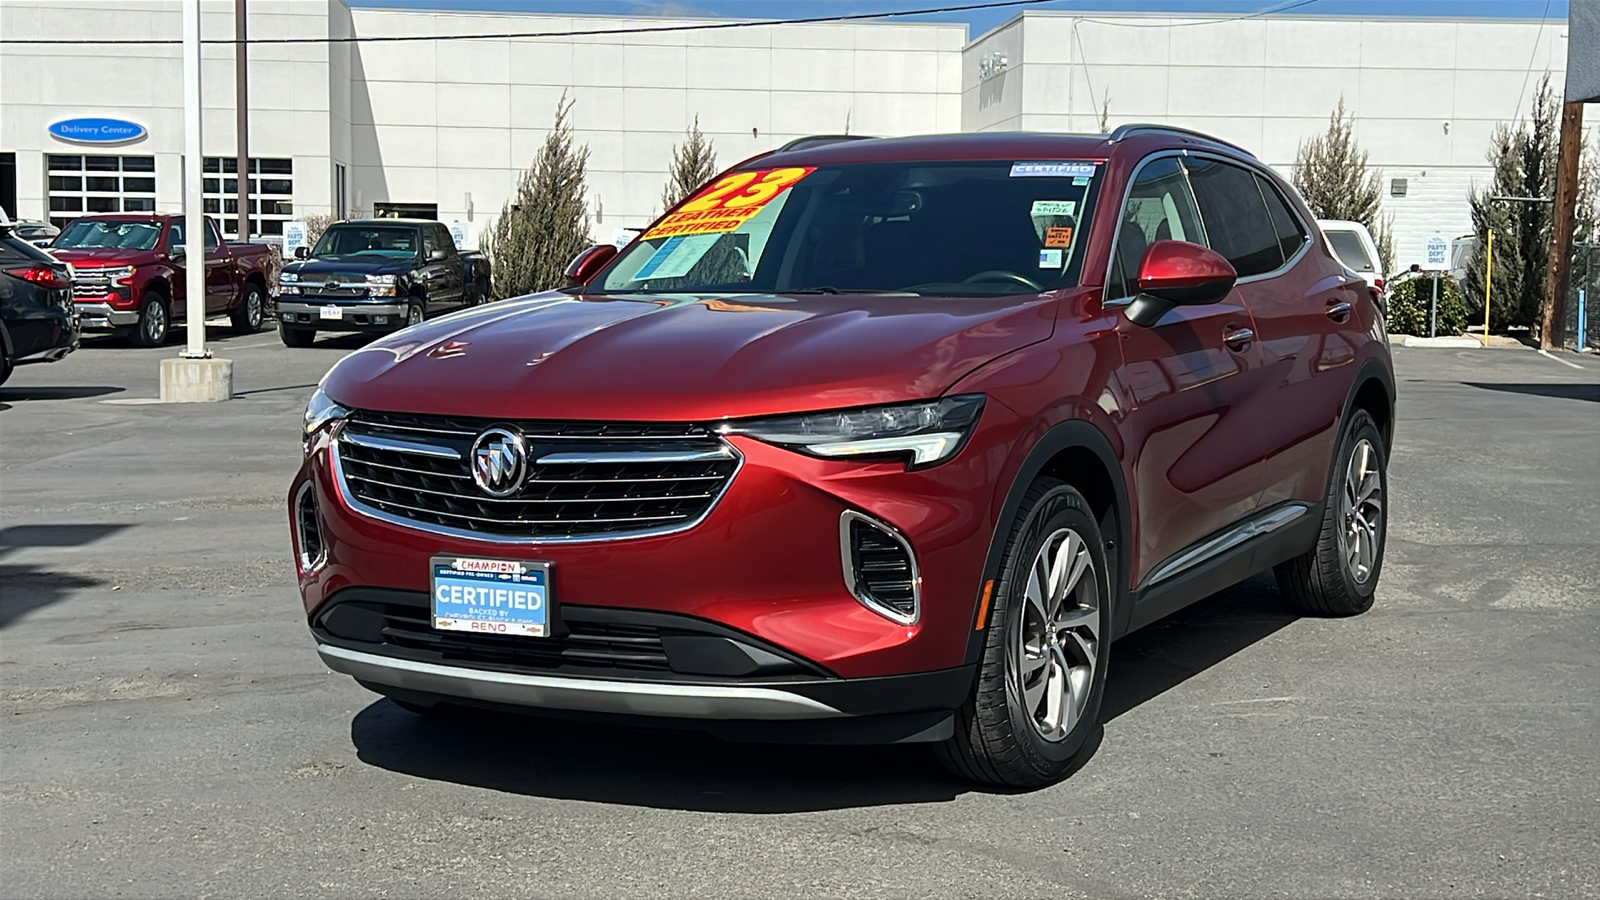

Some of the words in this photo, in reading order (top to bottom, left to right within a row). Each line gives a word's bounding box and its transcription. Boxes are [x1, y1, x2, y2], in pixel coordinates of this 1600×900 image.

[61, 125, 99, 135] Delivery
[101, 125, 133, 134] Center
[1015, 165, 1092, 173] CERTIFIED
[678, 167, 806, 213] 23
[663, 206, 759, 225] LEATHER
[645, 219, 741, 238] CERTIFIED
[461, 560, 516, 572] CHAMPION
[436, 584, 542, 610] CERTIFIED
[468, 607, 498, 616] BACKED
[471, 621, 507, 632] RENO
